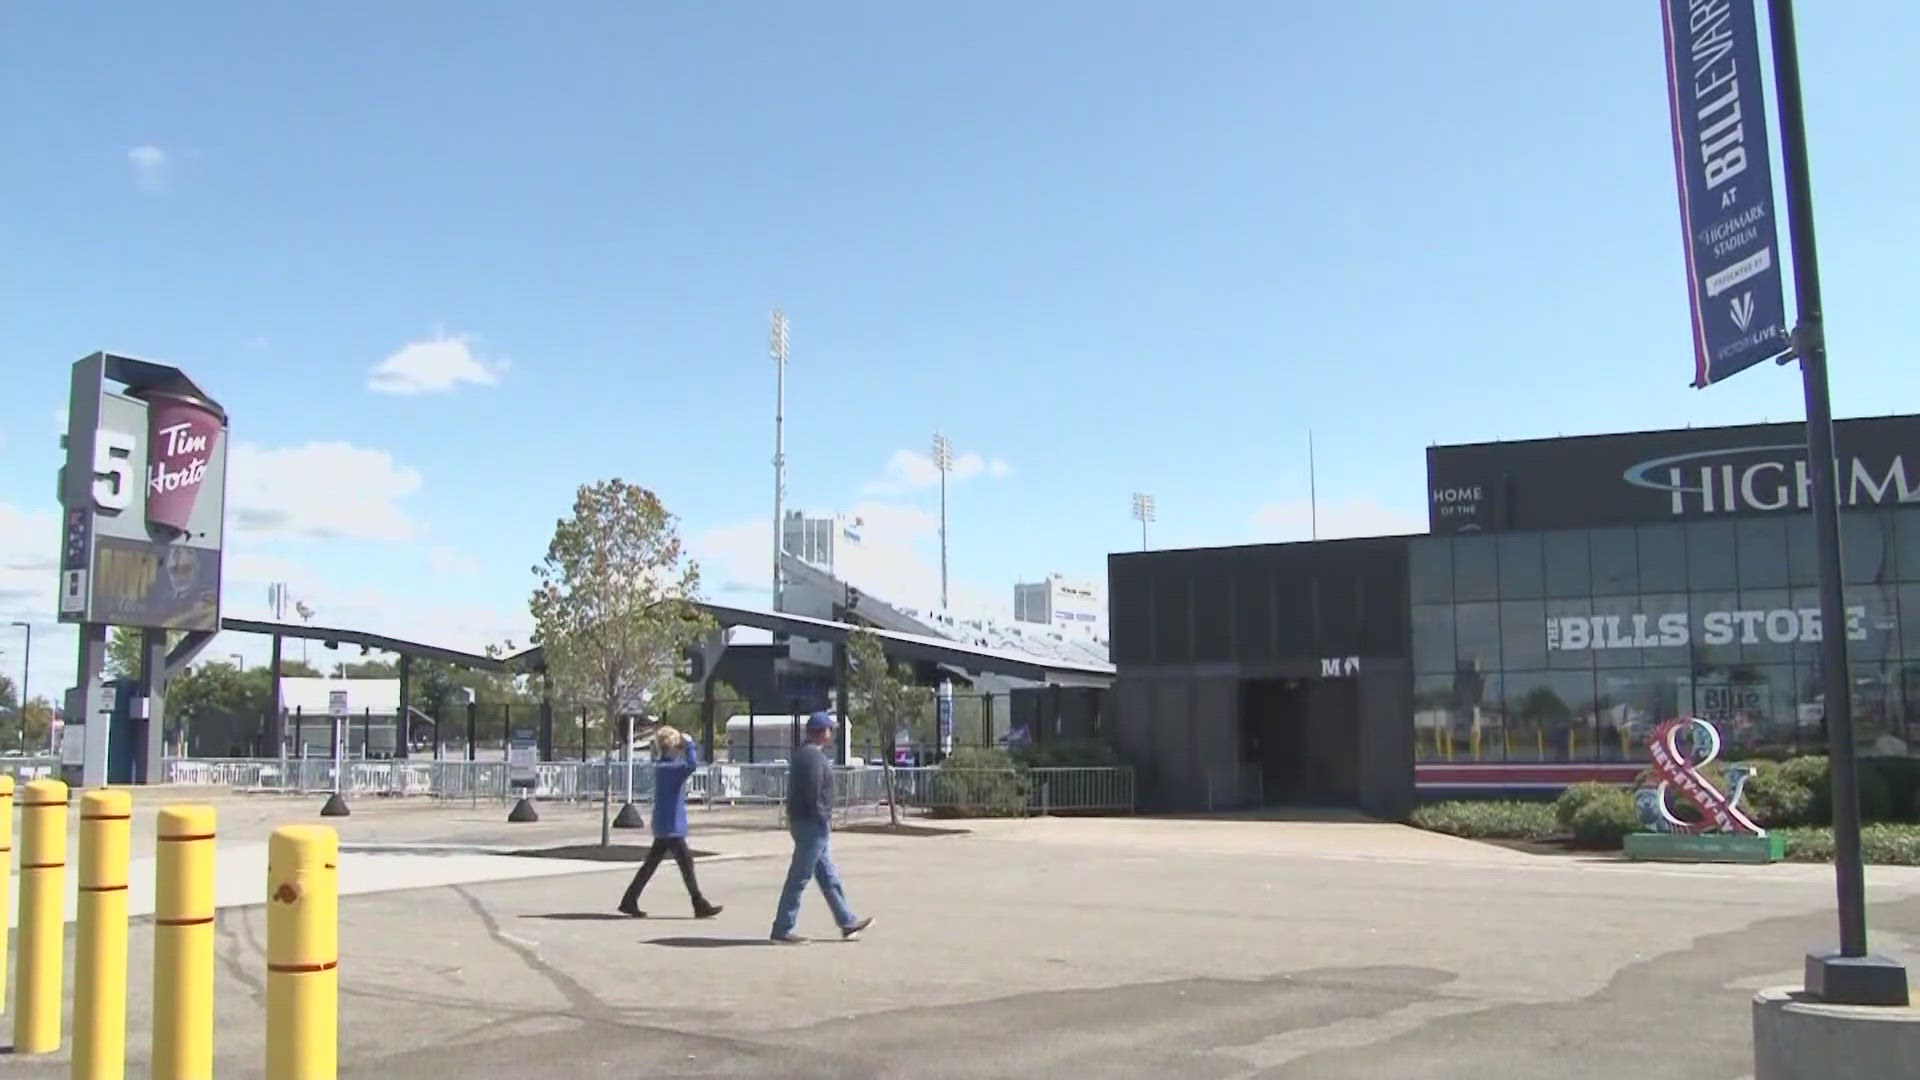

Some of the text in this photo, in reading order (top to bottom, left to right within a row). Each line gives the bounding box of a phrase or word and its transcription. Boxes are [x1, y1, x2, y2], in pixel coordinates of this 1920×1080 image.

[1689, 0, 1747, 191] BILLEVAR
[1721, 187, 1737, 210] AT
[1703, 202, 1766, 246] HIGHMARK
[1713, 226, 1758, 259] STADIUM
[159, 422, 207, 457] Tim
[91, 428, 136, 511] 5
[1670, 455, 1920, 514] HIGHM
[1433, 487, 1483, 502] HOME
[1441, 504, 1476, 516] OF THE
[1547, 617, 1560, 651] THE
[1560, 612, 1690, 651] BILLS
